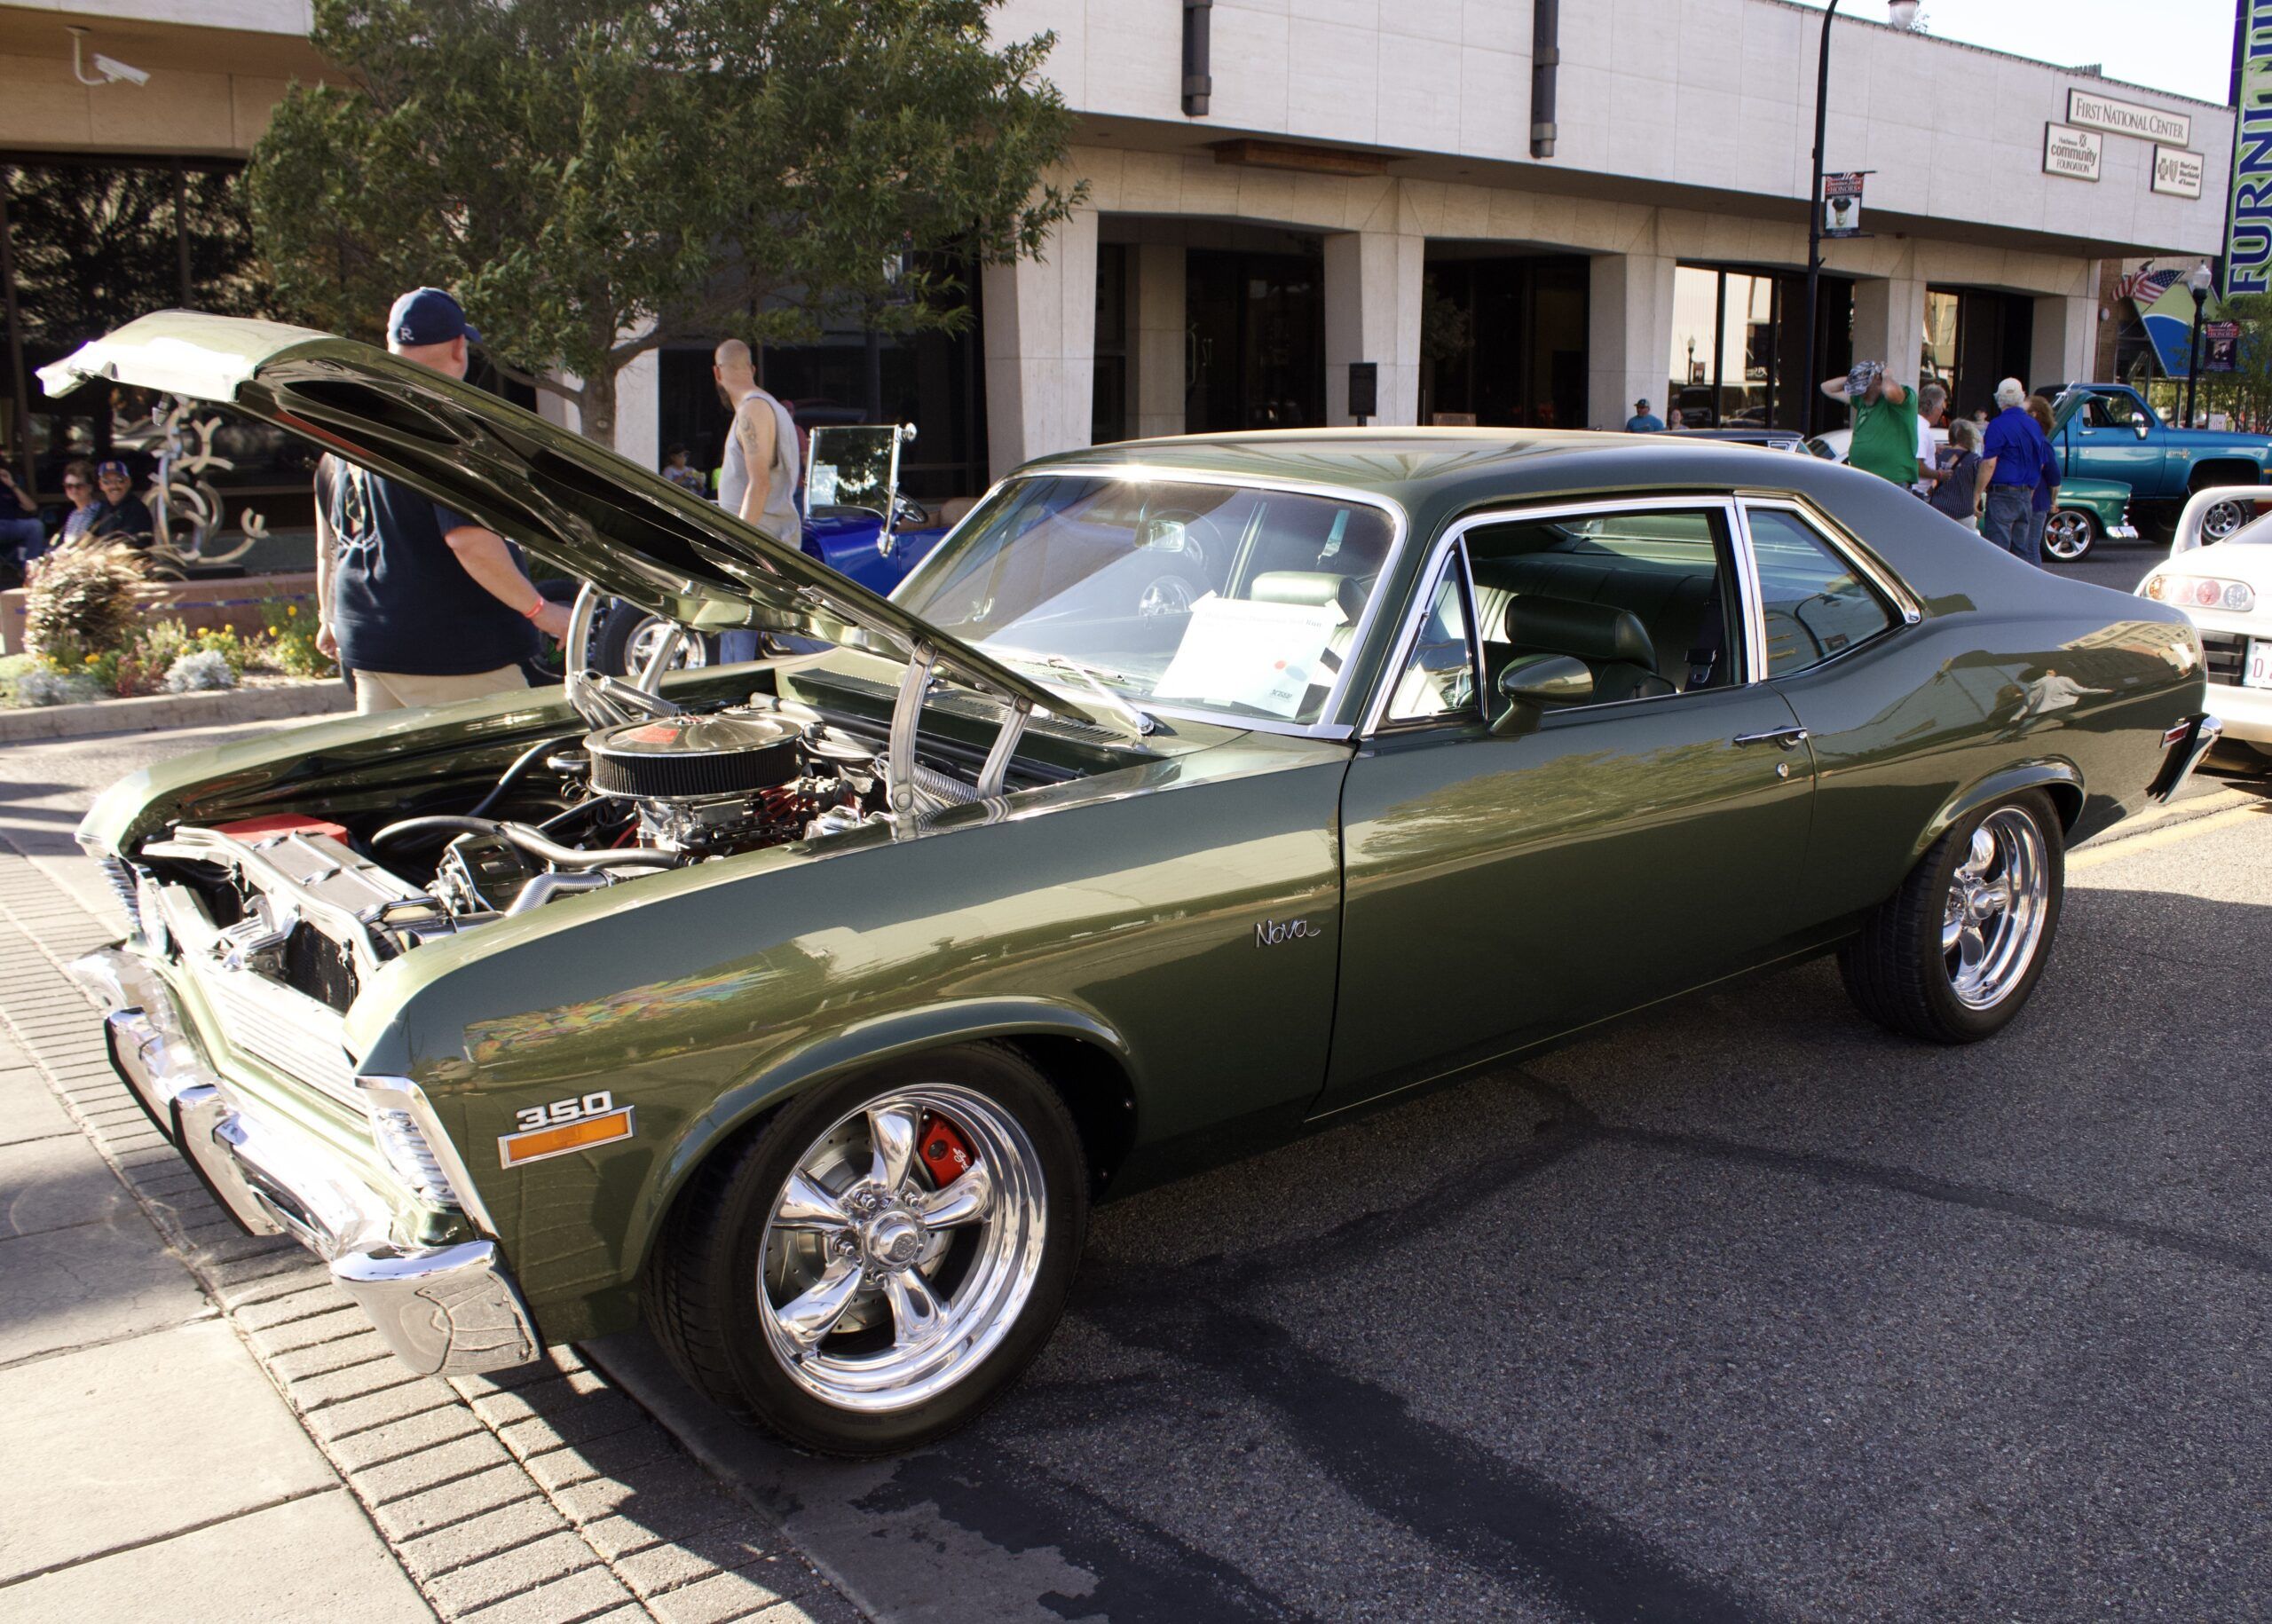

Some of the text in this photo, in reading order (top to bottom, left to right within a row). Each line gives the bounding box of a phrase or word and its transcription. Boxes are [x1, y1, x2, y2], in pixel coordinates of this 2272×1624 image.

[2076, 98, 2184, 138] FIRST NATIONAL CENTER
[2051, 144, 2097, 167] community
[2056, 159, 2090, 173] FOUNDATION
[400, 327, 414, 341] R
[1255, 918, 1321, 948] Nova
[516, 1091, 612, 1131] 350
